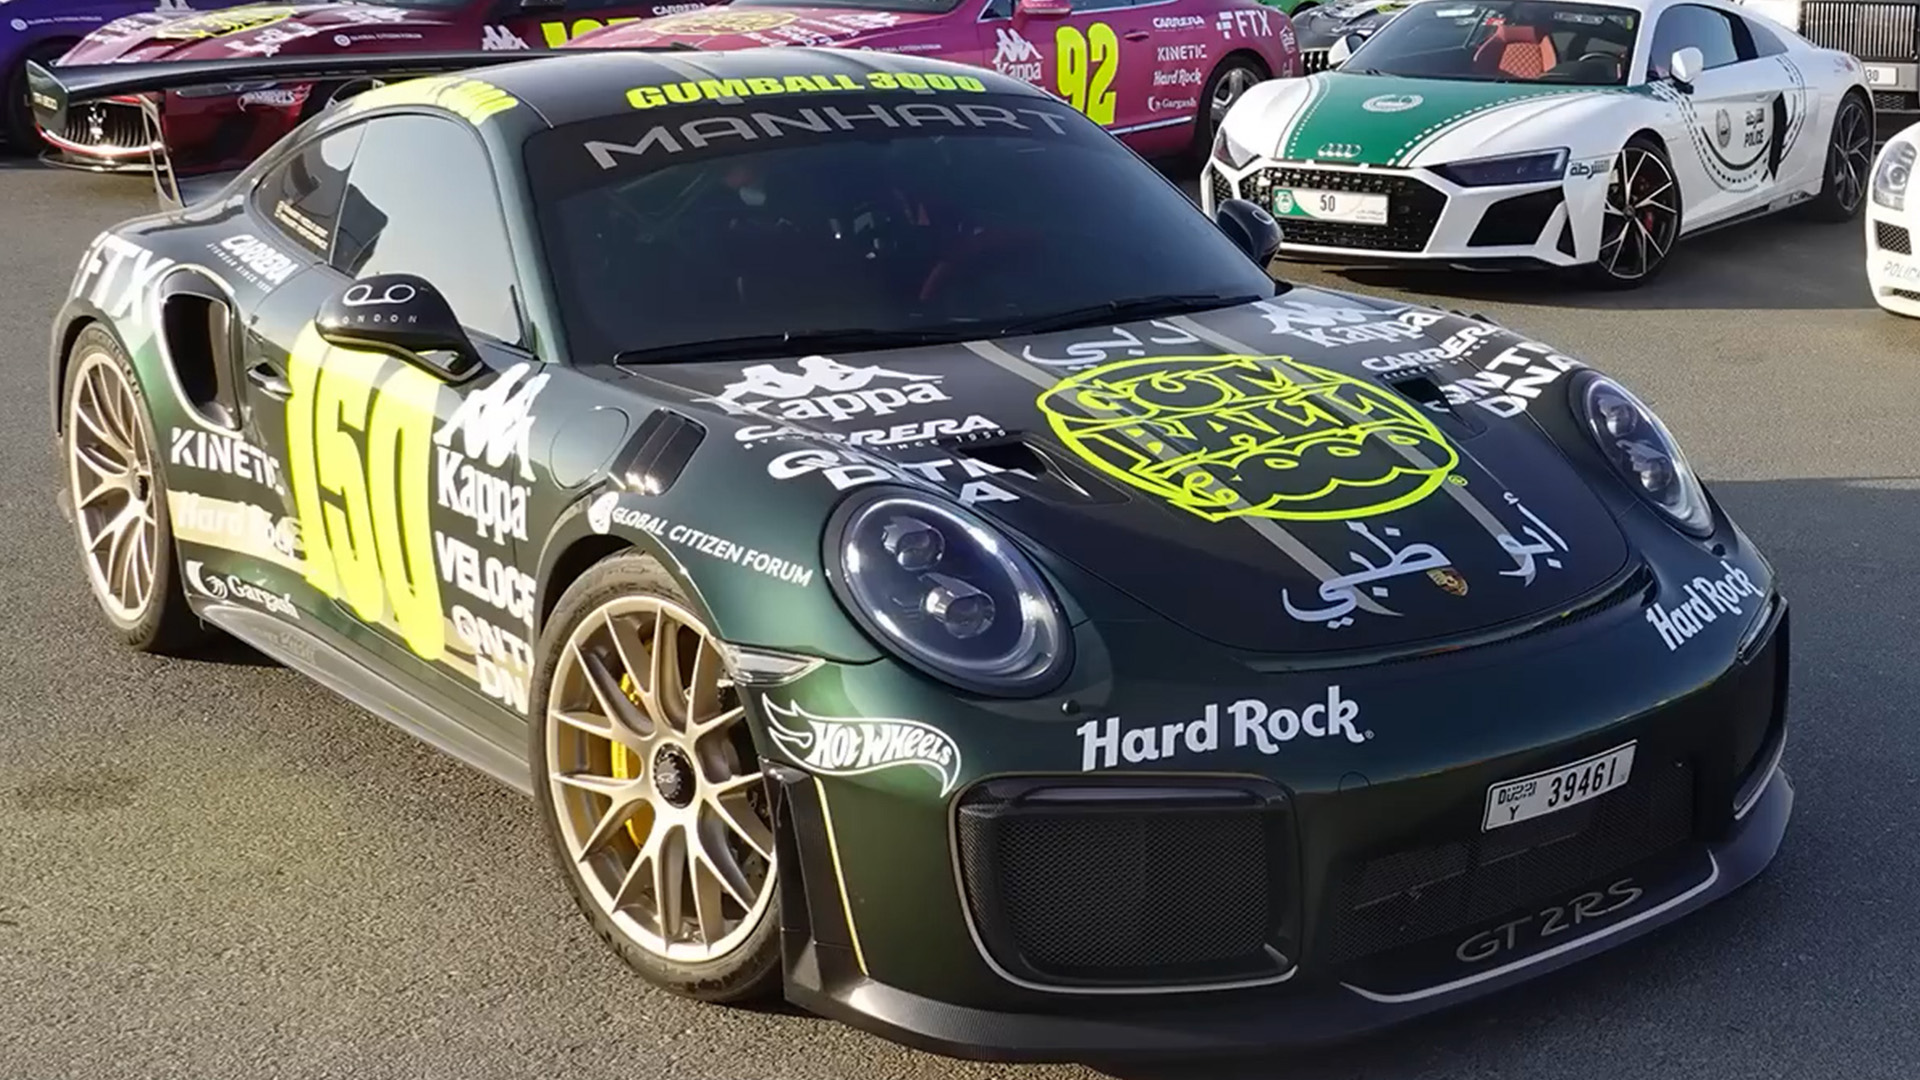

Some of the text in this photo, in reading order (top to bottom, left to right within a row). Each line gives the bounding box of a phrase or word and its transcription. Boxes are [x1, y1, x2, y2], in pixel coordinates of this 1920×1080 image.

[1153, 16, 1205, 28] CARRERA
[1235, 10, 1273, 37] FTX
[1056, 22, 1118, 125] 92
[1153, 68, 1202, 86] Hard Rock
[1157, 45, 1207, 61] KINETIC
[626, 71, 987, 109] GUMBALL 3000
[1162, 97, 1197, 110] Gargash
[584, 103, 1065, 170] MANHART
[1743, 129, 1764, 148] POLICE
[1320, 194, 1336, 212] 50
[221, 235, 299, 284] CARRERA
[1294, 312, 1446, 348] Kappa
[1361, 322, 1499, 371] CARRER
[726, 380, 953, 422] Kappa
[1475, 354, 1583, 419] DNA
[170, 428, 285, 497] KINETIC
[286, 320, 446, 661] 150
[437, 445, 532, 545] Kappa
[611, 505, 814, 588] GLOBAL CITIZEN FORUM
[227, 575, 301, 621] Gargash
[436, 531, 537, 630] VELOCE
[1645, 560, 1765, 651] Hard Rock
[1076, 685, 1364, 772] Hard Rock
[1548, 756, 1618, 808] 39461
[1510, 805, 1520, 820] Y
